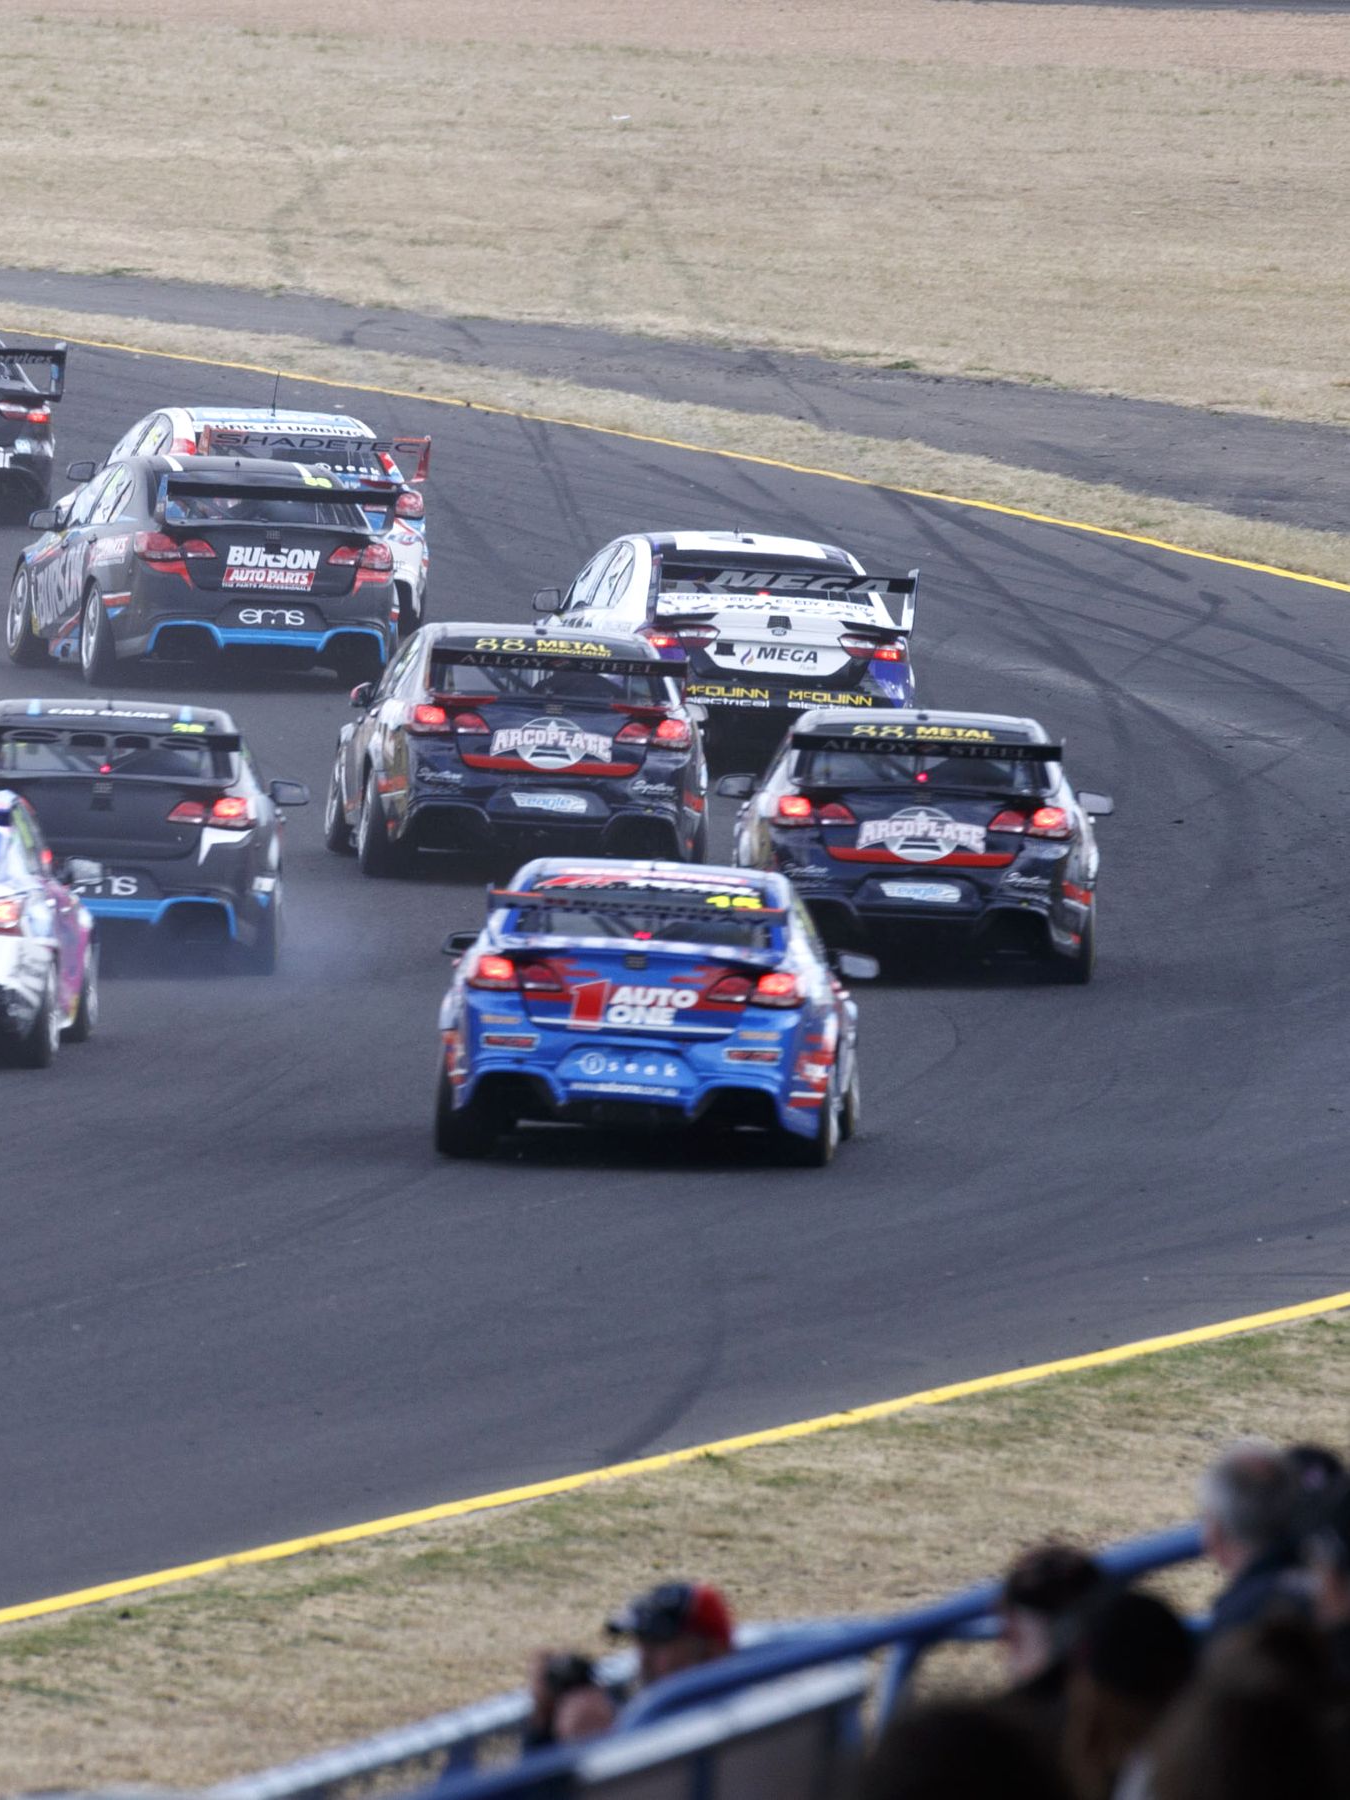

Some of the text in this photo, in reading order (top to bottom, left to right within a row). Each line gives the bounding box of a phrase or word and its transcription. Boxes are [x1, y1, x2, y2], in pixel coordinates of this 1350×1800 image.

[226, 545, 320, 570] BURSON
[230, 570, 309, 585] AUTO PARTS
[712, 571, 891, 593] MEGA
[536, 639, 607, 651] METAL
[459, 654, 660, 675] ALLOY STEEL
[757, 646, 818, 664] MEGA
[788, 690, 872, 706] McQUINN
[916, 726, 996, 740] METAL
[610, 985, 698, 1008] AUTO
[607, 1004, 677, 1026] ONE
